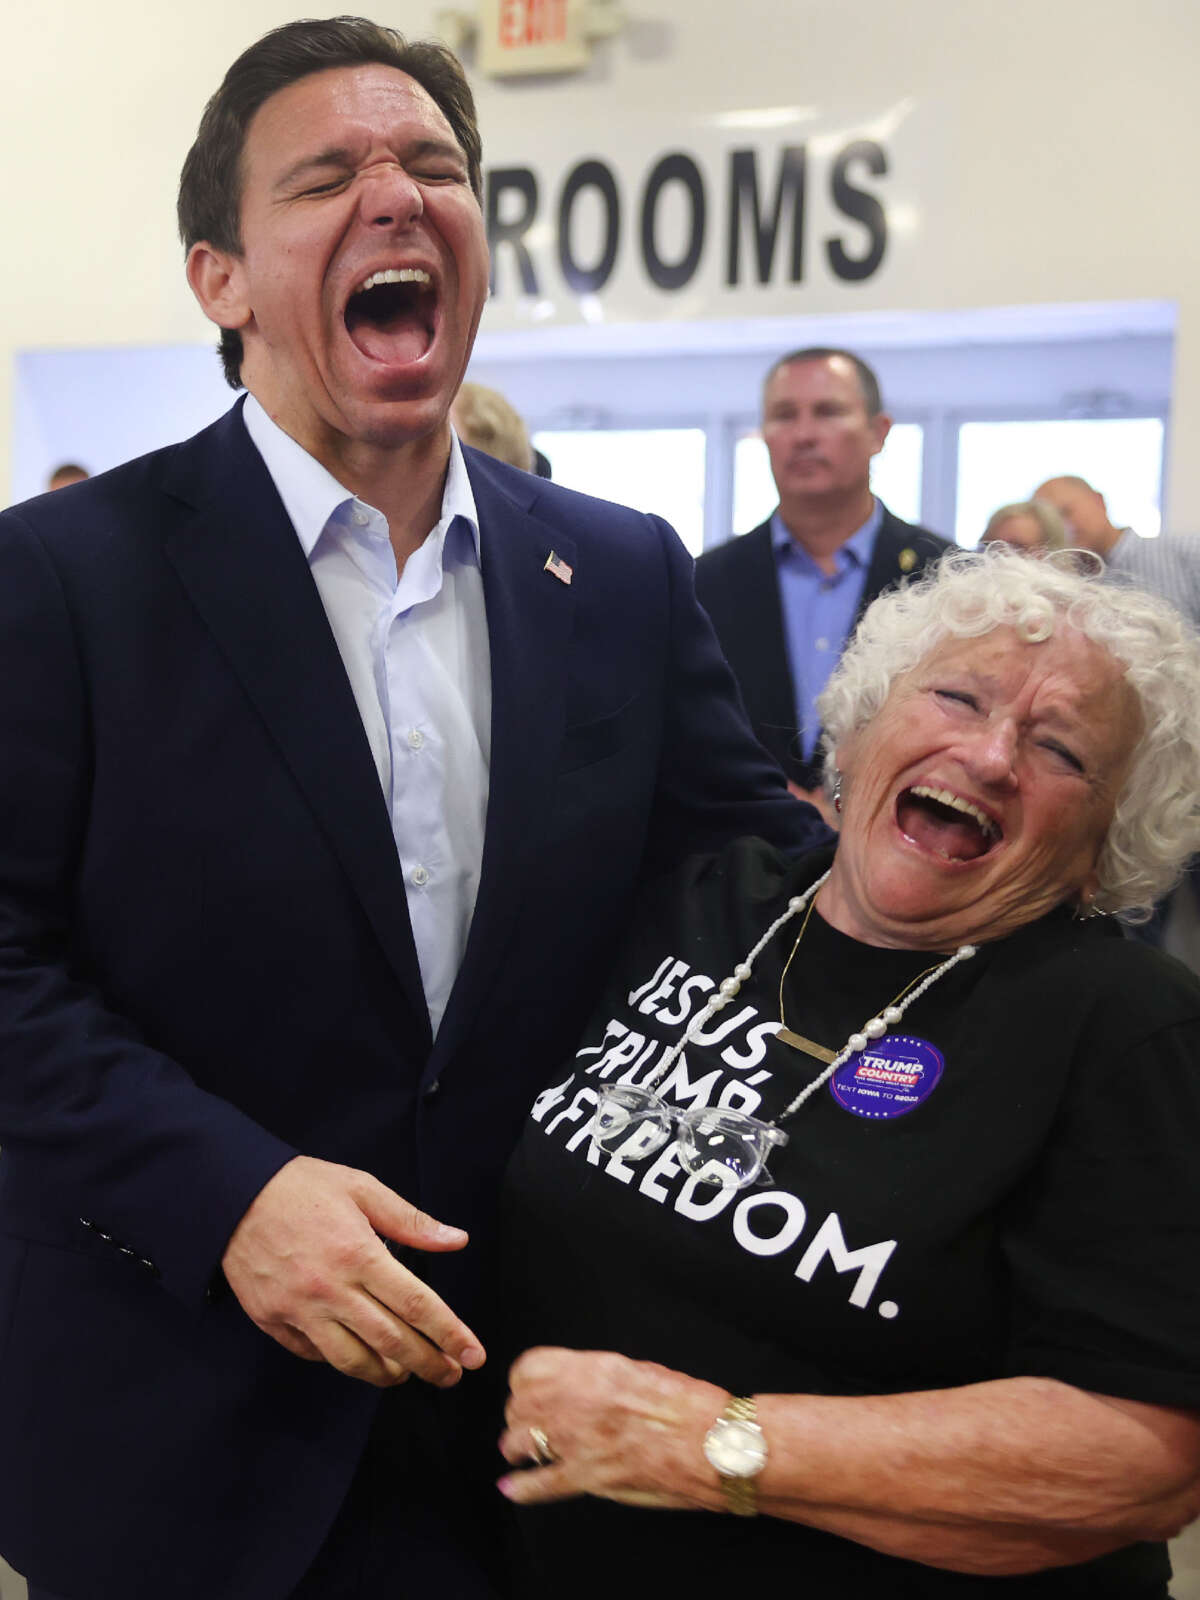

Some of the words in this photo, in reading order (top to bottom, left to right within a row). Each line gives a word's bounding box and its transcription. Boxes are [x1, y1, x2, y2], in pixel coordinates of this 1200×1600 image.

[498, 0, 568, 48] EXIT
[863, 1056, 923, 1074] TRUMP
[858, 1067, 916, 1084] COUNTRY
[837, 1083, 856, 1093] TEXT
[857, 1088, 880, 1098] IOWA
[882, 1092, 893, 1100] TO
